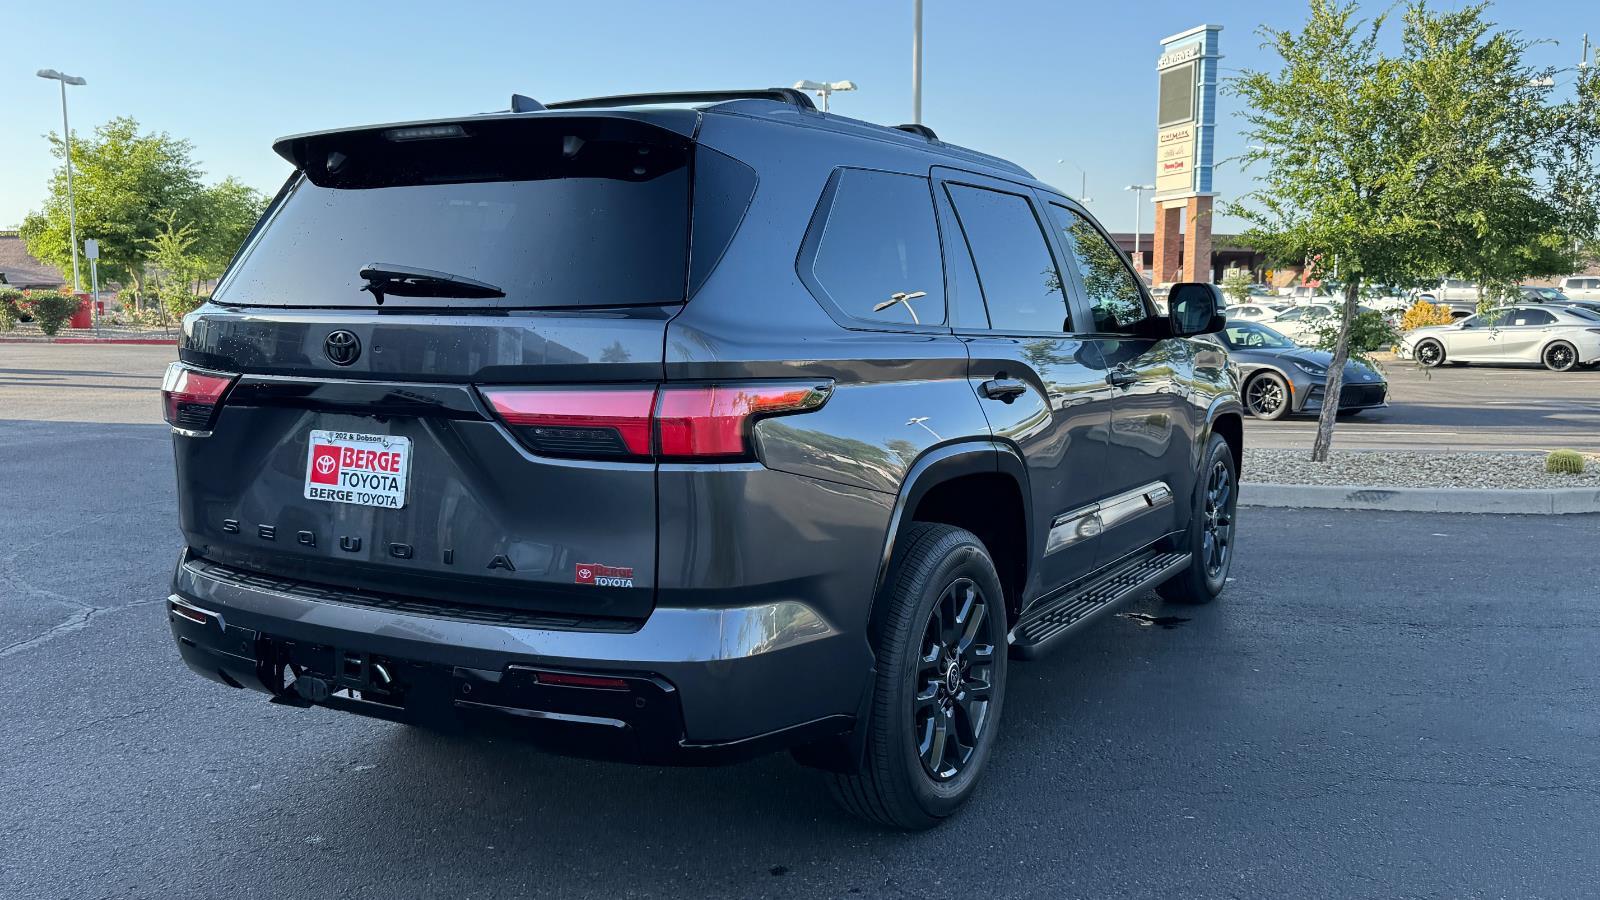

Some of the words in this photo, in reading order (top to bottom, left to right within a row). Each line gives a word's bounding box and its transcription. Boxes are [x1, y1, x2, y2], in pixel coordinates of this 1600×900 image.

[335, 432, 348, 440] 202
[349, 433, 355, 441] &
[356, 434, 382, 443] Dobson
[342, 447, 401, 473] BERGE
[340, 471, 400, 492] TOYOTA
[309, 487, 354, 502] BERGE
[356, 492, 398, 507] TOYOTA
[223, 518, 516, 572] SEQUOIA
[594, 577, 633, 588] TOYOTA
